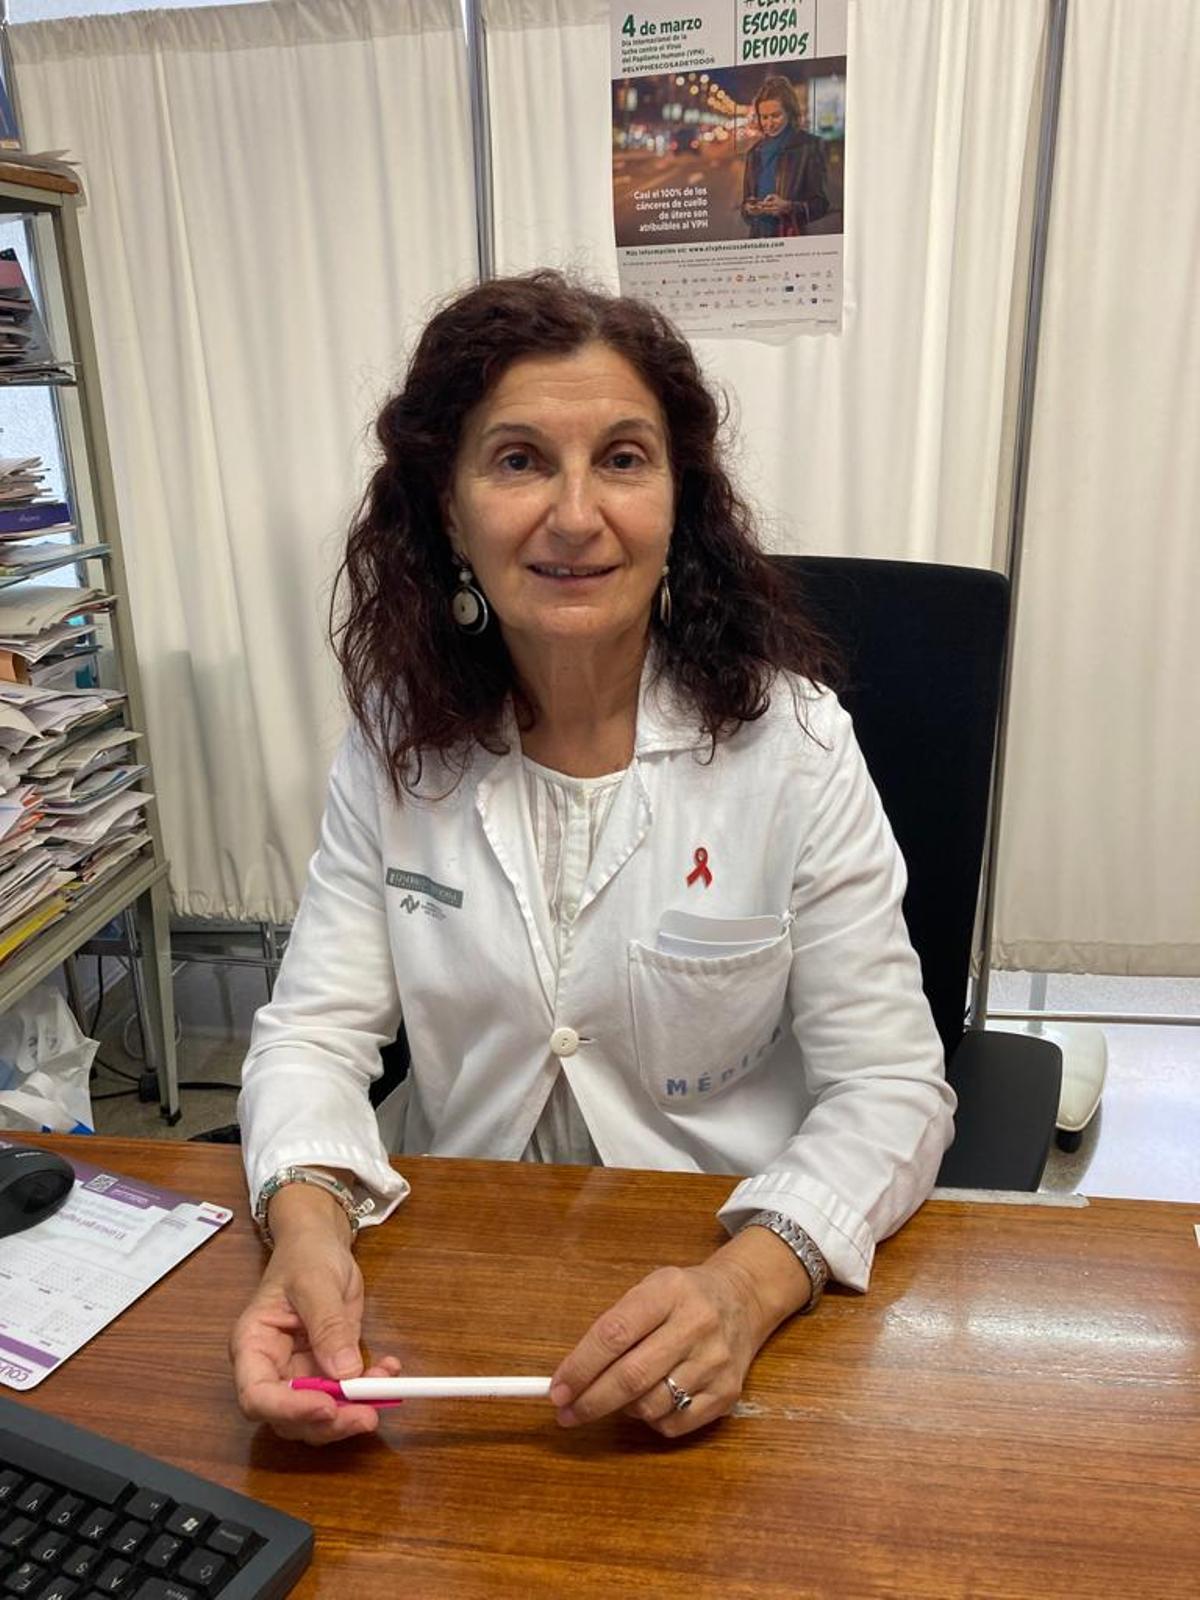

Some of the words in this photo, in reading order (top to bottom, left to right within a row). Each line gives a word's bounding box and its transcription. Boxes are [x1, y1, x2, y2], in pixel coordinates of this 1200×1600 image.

[622, 14, 636, 37] 4
[640, 21, 657, 36] de
[660, 18, 702, 33] marzo
[743, 8, 797, 35] ESCOSA
[743, 32, 809, 60] DETODOS
[634, 190, 650, 200] Casi
[652, 189, 659, 199] el
[661, 188, 682, 197] 100%
[683, 187, 693, 196] de
[695, 187, 707, 195] los
[636, 201, 670, 210] cánceres
[671, 200, 681, 208] de
[683, 198, 708, 207] cuello
[659, 211, 669, 220] de
[693, 209, 708, 217] son
[639, 221, 680, 232] atribuibles
[682, 220, 689, 230] al
[690, 220, 709, 228] VPH
[89, 1525, 103, 1537] X
